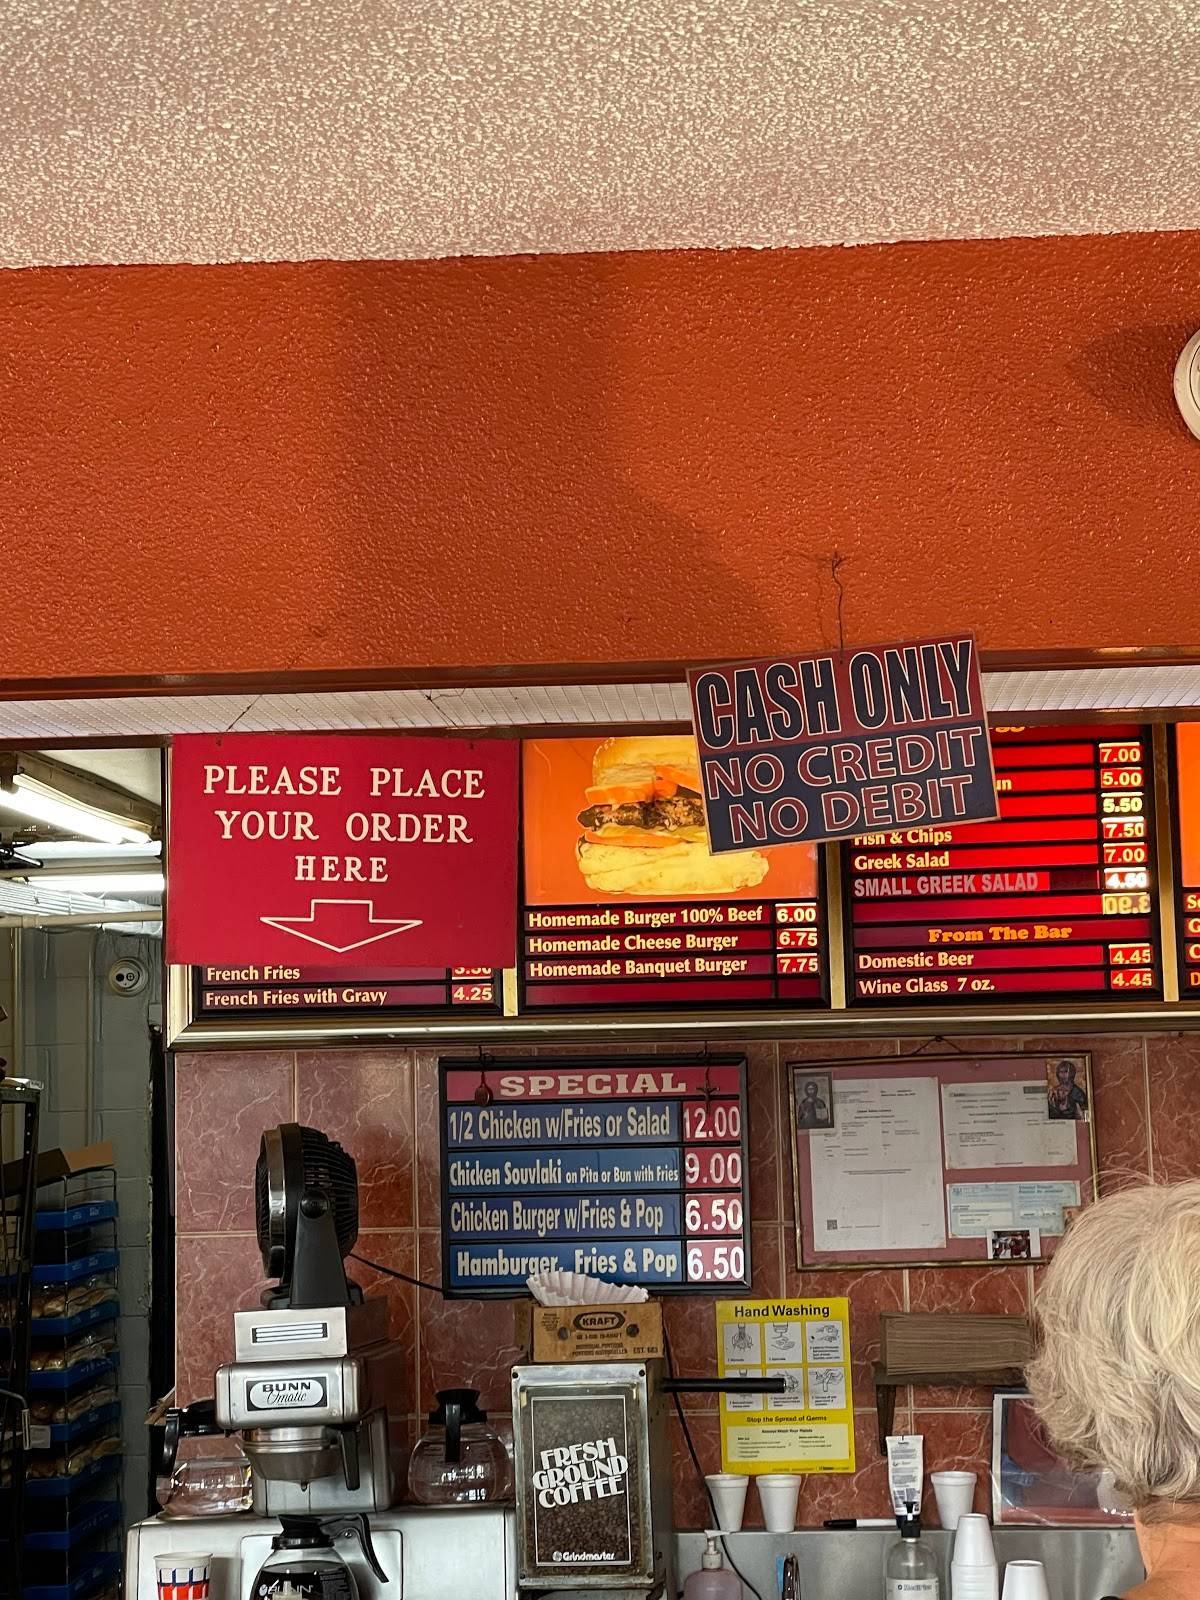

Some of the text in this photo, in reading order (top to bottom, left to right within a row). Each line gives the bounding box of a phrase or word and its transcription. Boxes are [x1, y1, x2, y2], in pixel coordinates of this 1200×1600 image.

[695, 639, 972, 750] CASH ONLY
[704, 726, 982, 800] NO CREDIT
[1101, 748, 1140, 762] 7.00
[203, 766, 485, 798] PLEASE PLACE
[1103, 772, 1142, 786] 5.00
[728, 775, 972, 844] NO DEBIT
[1103, 797, 1143, 813] 5.50
[214, 810, 473, 843] YOUR ORDER
[1105, 823, 1144, 837] 7.50
[907, 828, 952, 845] Chips
[854, 851, 950, 870] Greek Salad
[1105, 848, 1145, 863] 7.00
[295, 856, 389, 882] HERE
[854, 872, 1038, 897] SMALL GREEK SALAD
[528, 906, 763, 928] Homemade Burger 100% Beef
[776, 908, 816, 923] 6.00
[529, 934, 738, 953] Homemade Cheese Burger
[779, 931, 818, 947] 6.75
[928, 925, 1073, 943] From The Bar
[779, 958, 818, 973] 7.75
[858, 952, 974, 969] Domestic Beer
[1112, 950, 1151, 965] 4.45
[207, 965, 300, 981] French Fries
[530, 958, 747, 978] Homemade Banquet Burger
[859, 978, 995, 994] Wine Glass 7 oz.
[1112, 973, 1152, 987] 4.45
[206, 989, 388, 1006] French Fries with Gravy
[453, 986, 492, 1000] 4.25
[500, 1073, 686, 1097] SPECIAL
[450, 1106, 670, 1144] 1/2 Chicken w/Fries or Salad
[683, 1106, 740, 1138] 12.00
[450, 1158, 679, 1187] Chicken Souvlaki on Pita or Bun with Fries
[685, 1153, 742, 1184] 9.00
[450, 1198, 664, 1237] Chicken Burger w/Fries & Pop
[685, 1199, 743, 1231] 6.50
[574, 1247, 617, 1274] Fries
[623, 1248, 637, 1273] &
[642, 1248, 677, 1277] Pop
[687, 1247, 745, 1280] 6.50
[735, 1304, 830, 1318] Hand Washing
[582, 1317, 616, 1326] KRAFT
[262, 1381, 311, 1393] BUNN
[540, 1437, 617, 1470] FRESH
[532, 1455, 628, 1490] GROUND
[538, 1475, 624, 1509] COFFEE
[562, 1551, 615, 1561] Grindmaster
